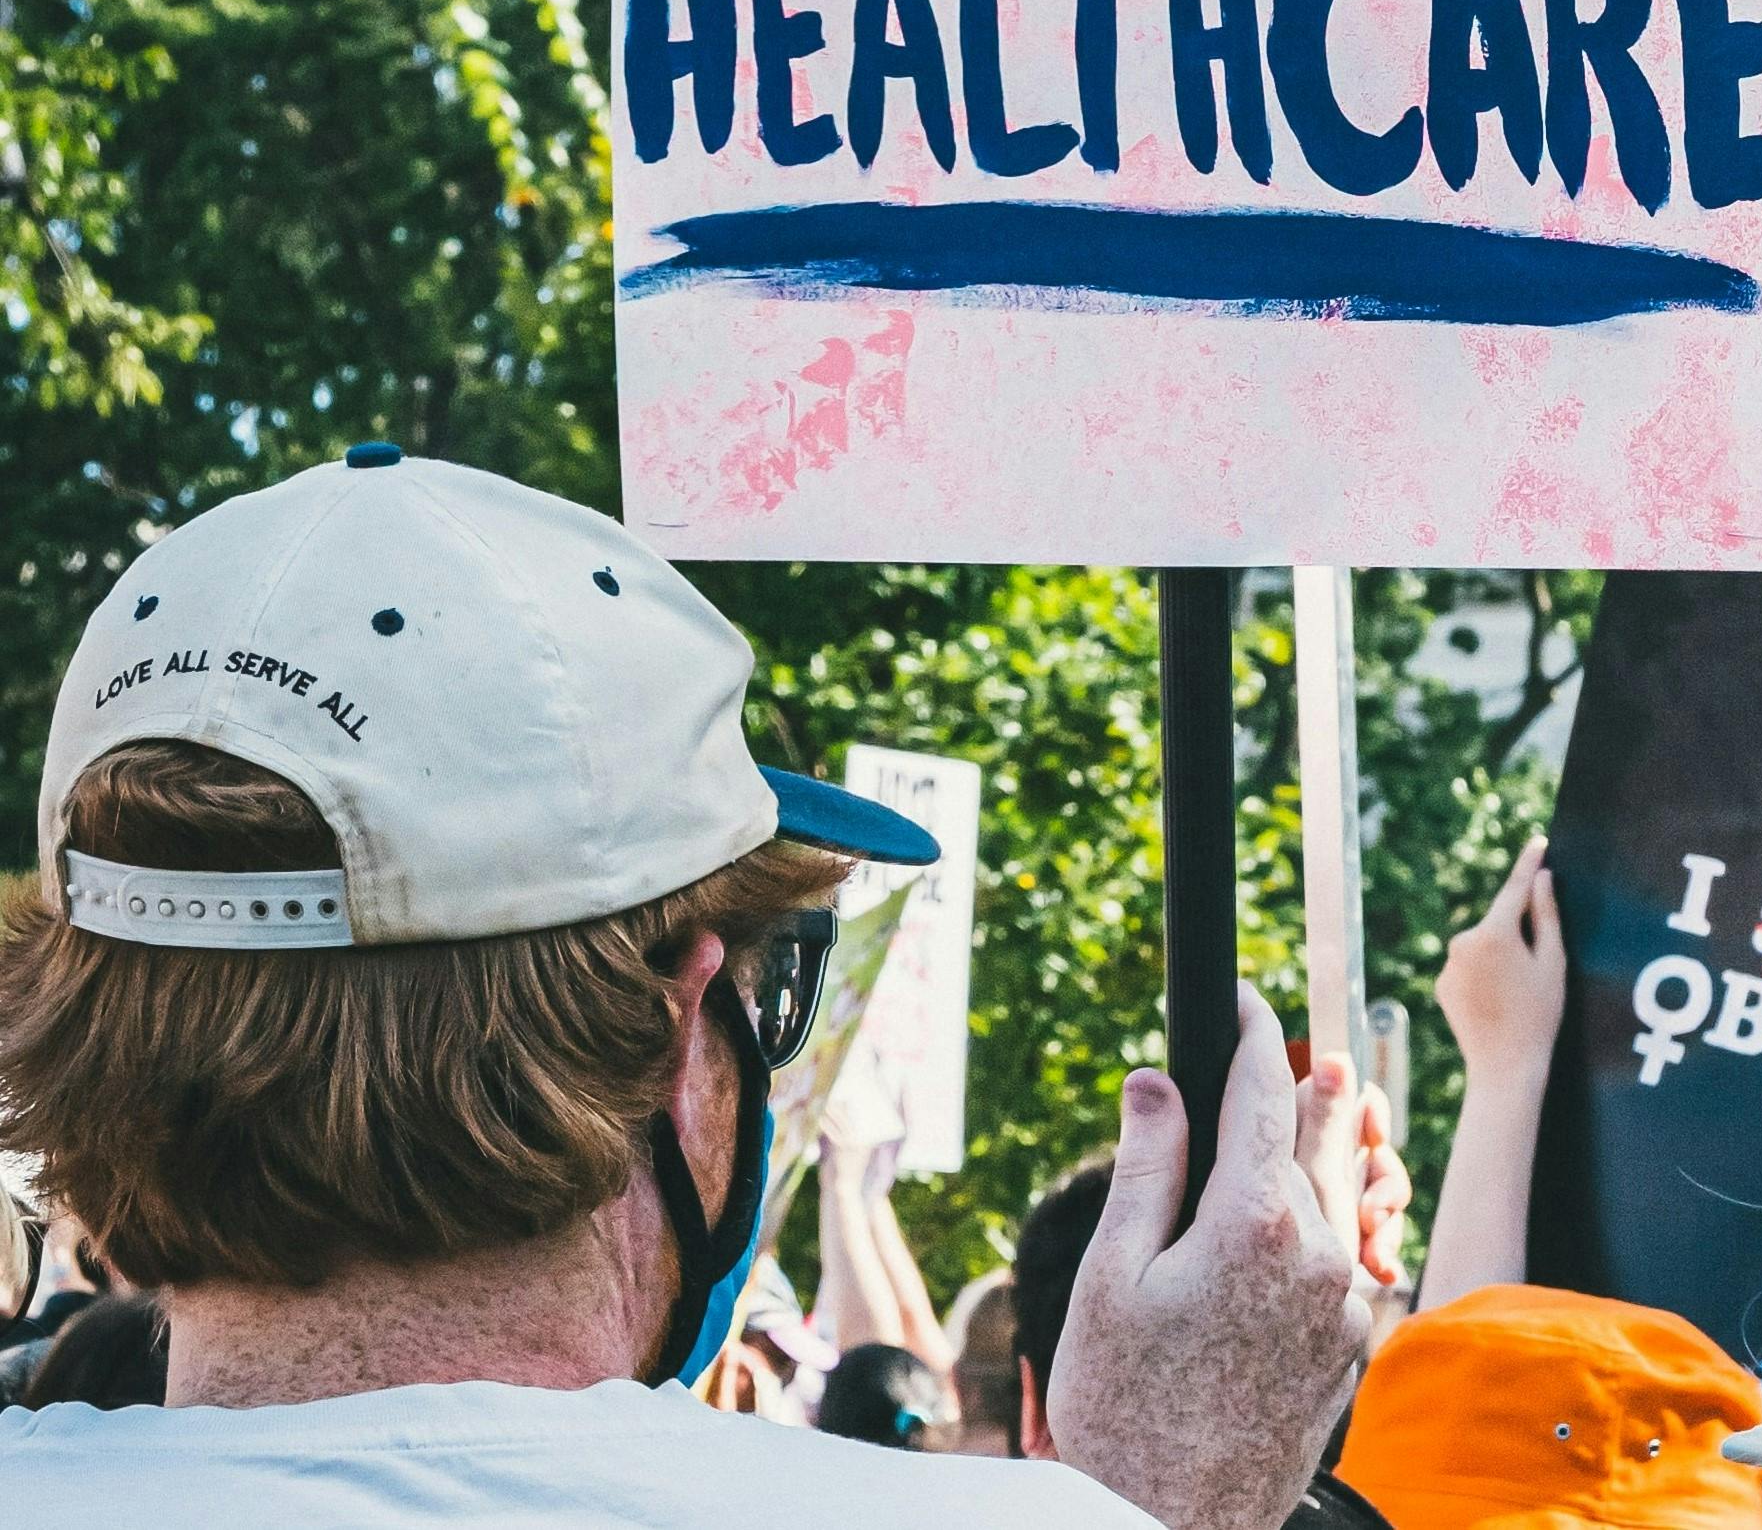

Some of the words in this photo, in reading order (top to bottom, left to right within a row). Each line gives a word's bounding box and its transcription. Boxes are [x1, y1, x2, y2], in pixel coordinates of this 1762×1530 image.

[96, 658, 154, 709] LOVE
[162, 650, 210, 676] ALL
[224, 650, 318, 697] SERVE
[317, 691, 369, 742] ALL
[1666, 852, 1726, 937] I
